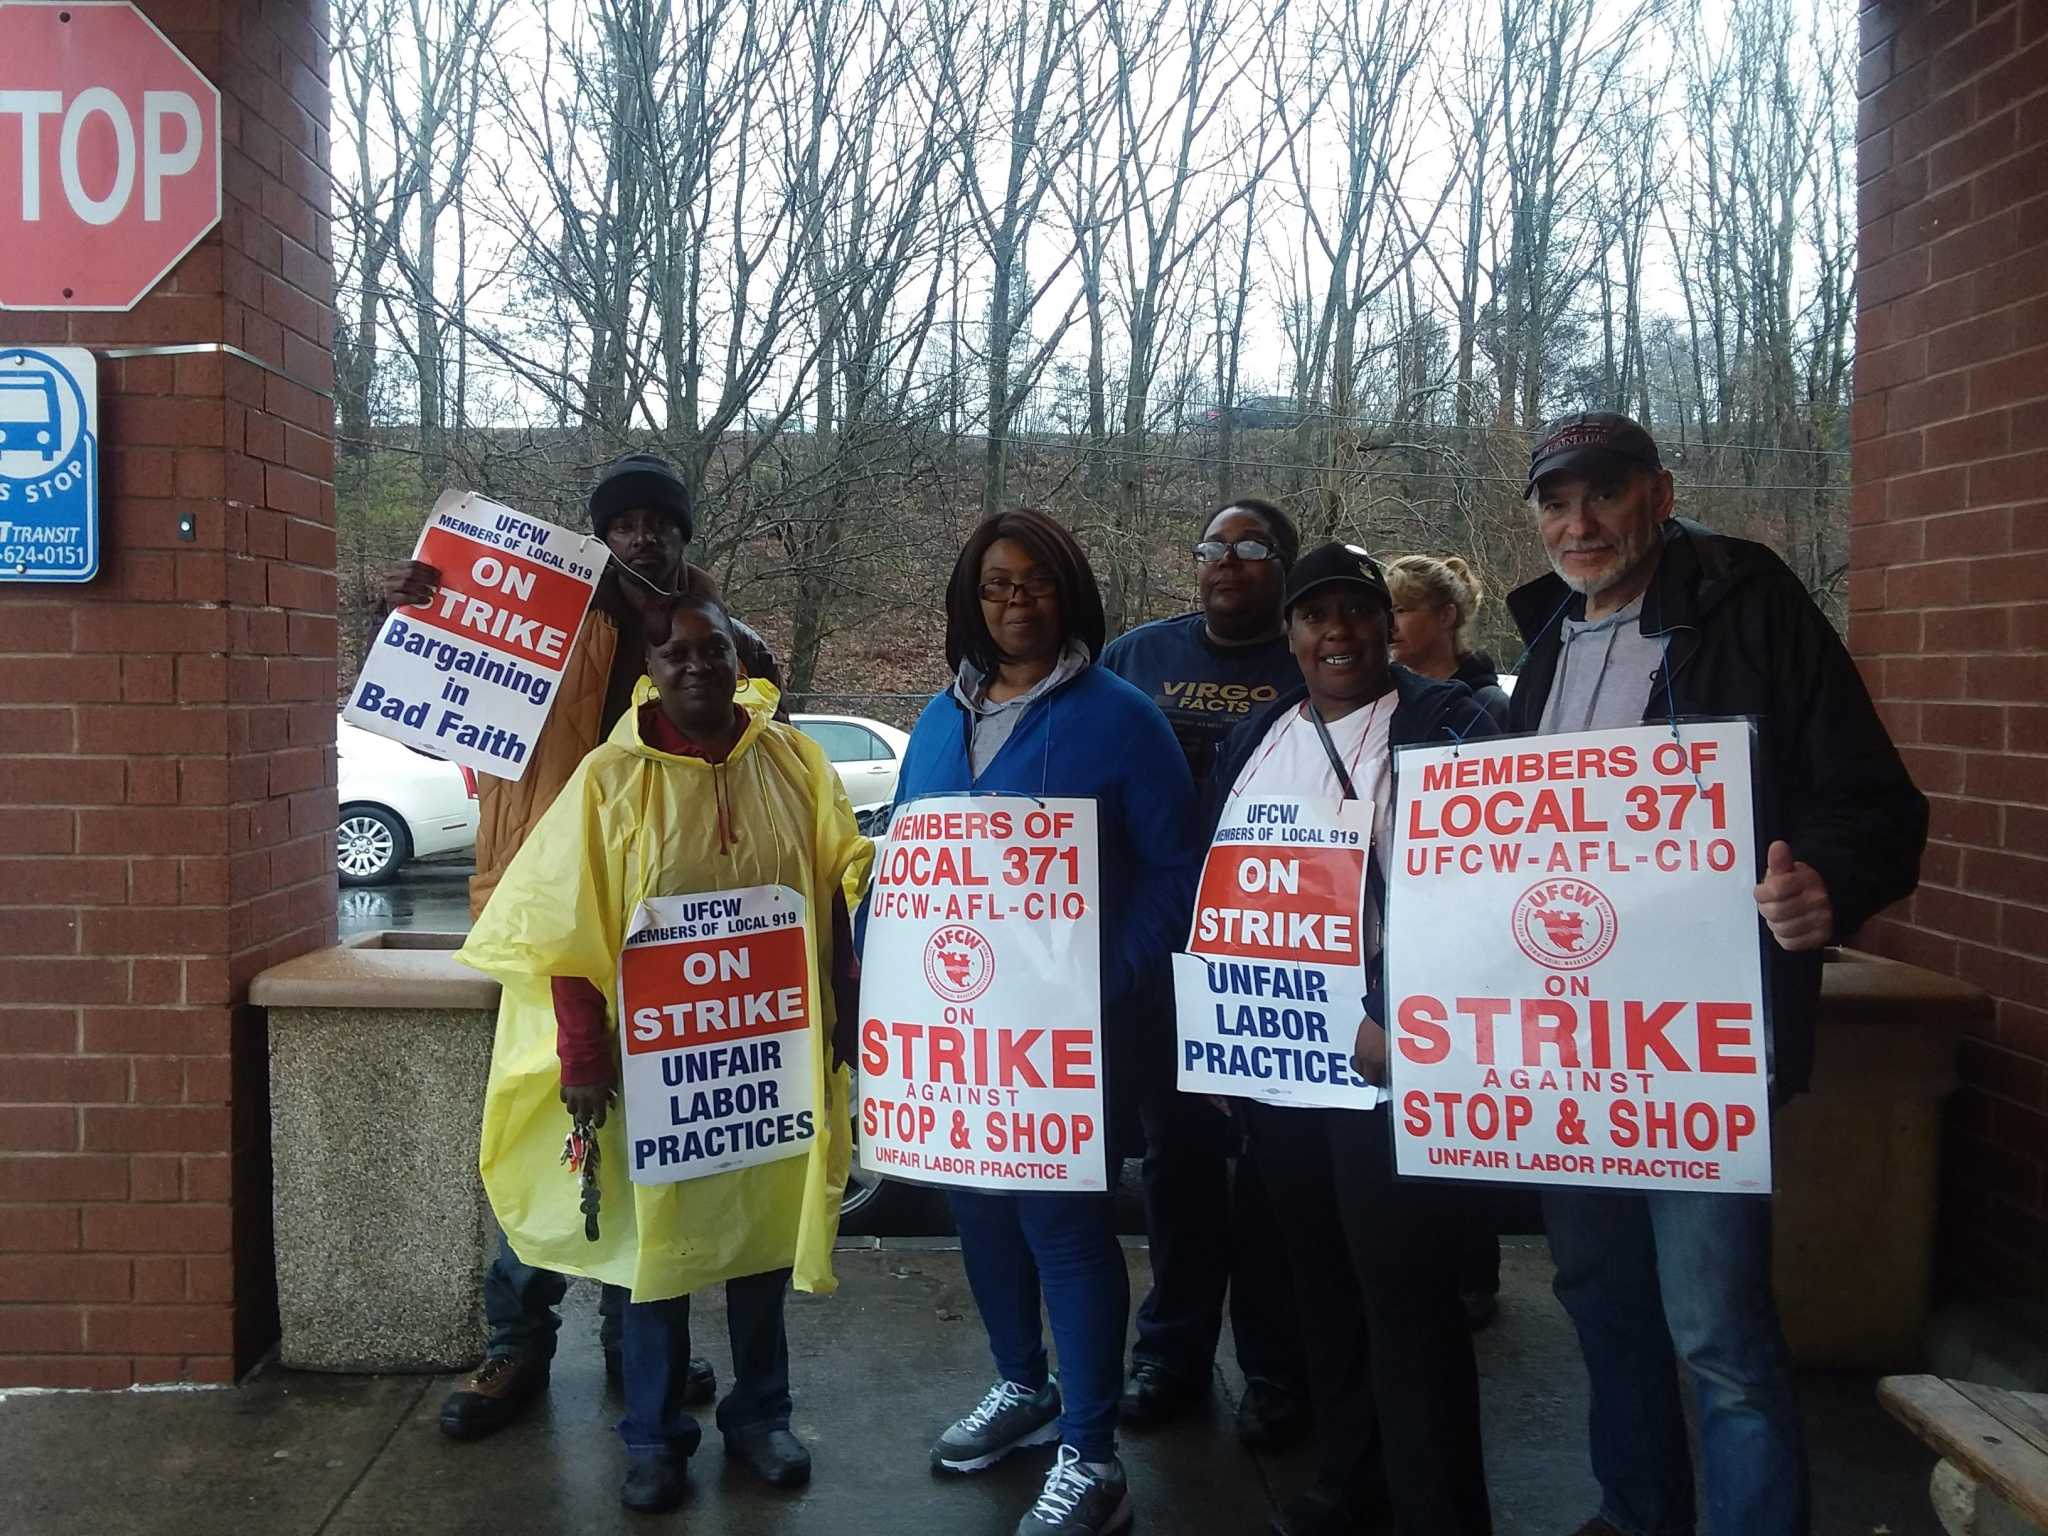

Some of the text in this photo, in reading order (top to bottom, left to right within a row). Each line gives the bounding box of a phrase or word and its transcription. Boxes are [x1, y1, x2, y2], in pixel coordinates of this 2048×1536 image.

[25, 460, 82, 503] STOP
[438, 514, 593, 580] MEMBERS OF LOCAL 919
[495, 514, 551, 546] UFCW
[471, 556, 537, 601] ON
[383, 619, 552, 706] Bargaining
[440, 677, 470, 706] in
[1163, 682, 1279, 701] VIRGO
[1178, 697, 1250, 713] FACTS
[355, 681, 527, 764] Bad Faith
[1423, 741, 1718, 792] MEMBERS OF
[891, 811, 1074, 841] MEMBERS OF
[1247, 804, 1300, 824] UFCW
[1408, 782, 1726, 840] LOCAL 371
[1216, 827, 1359, 844] MEMBERS OF LOCAL 919
[879, 847, 1078, 886] LOCAL 371
[1238, 857, 1299, 895] ON
[1406, 838, 1736, 876] UFCW-AFL-CIO
[683, 898, 742, 921] UFCW
[874, 891, 1085, 920] UFCW-AFL-CIO
[1528, 884, 1600, 907] UFCW
[701, 922, 719, 936] OF
[728, 916, 769, 933] LOCAL
[772, 911, 797, 926] 919
[934, 930, 981, 949] UFCW
[1199, 907, 1352, 952] STRIKE
[683, 947, 750, 985] ON
[1207, 962, 1329, 1003] UNFAIR
[1545, 975, 1590, 997] ON
[633, 987, 804, 1041] STRIKE
[944, 1006, 974, 1025] ON
[1216, 1003, 1329, 1043] LABOR
[1397, 994, 1757, 1074] STRIKE
[662, 1040, 782, 1086] UNFAIR
[862, 1019, 1095, 1089] STRIKE
[906, 1083, 1019, 1107] AGAINST
[1483, 1067, 1654, 1094] AGAINST
[670, 1079, 779, 1125] LABOR
[1404, 1090, 1756, 1152] STOP & SHOP
[635, 1110, 815, 1170] PRACTICES
[863, 1097, 1094, 1155] STOP & SHOP
[875, 1147, 1067, 1180] UNFAIR LABOR PRACTICE
[1428, 1147, 1720, 1180] UNFAIR LABOR PRACTICE
